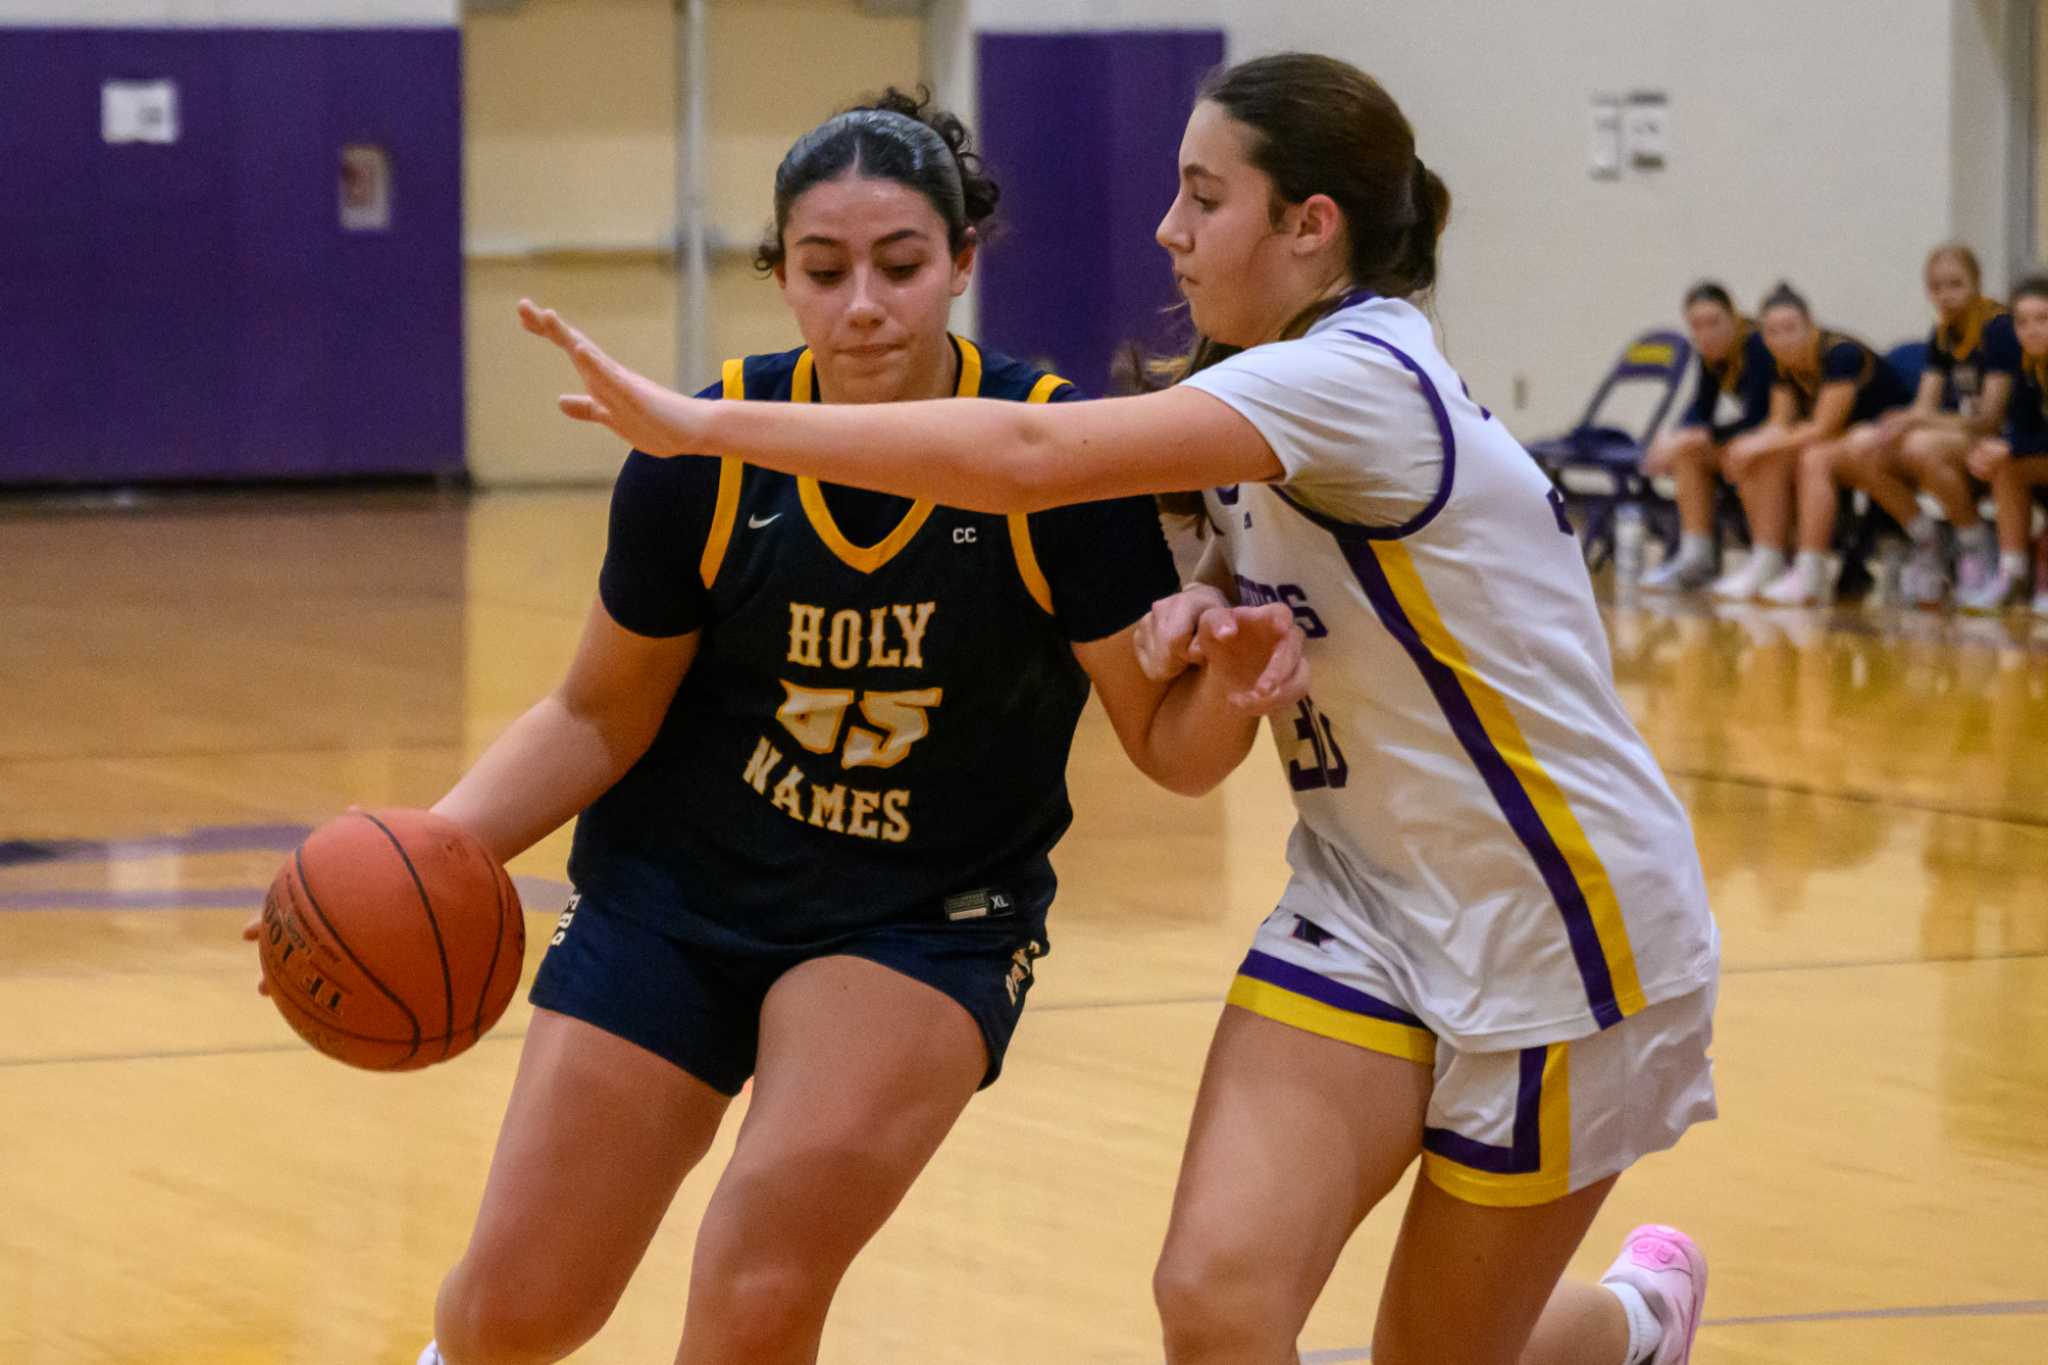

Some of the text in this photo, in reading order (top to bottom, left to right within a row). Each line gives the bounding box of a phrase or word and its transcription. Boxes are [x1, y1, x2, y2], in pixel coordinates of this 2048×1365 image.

[952, 526, 977, 544] CC
[786, 601, 936, 669] HOLY
[742, 735, 911, 843] NAMES
[990, 895, 1009, 909] XL
